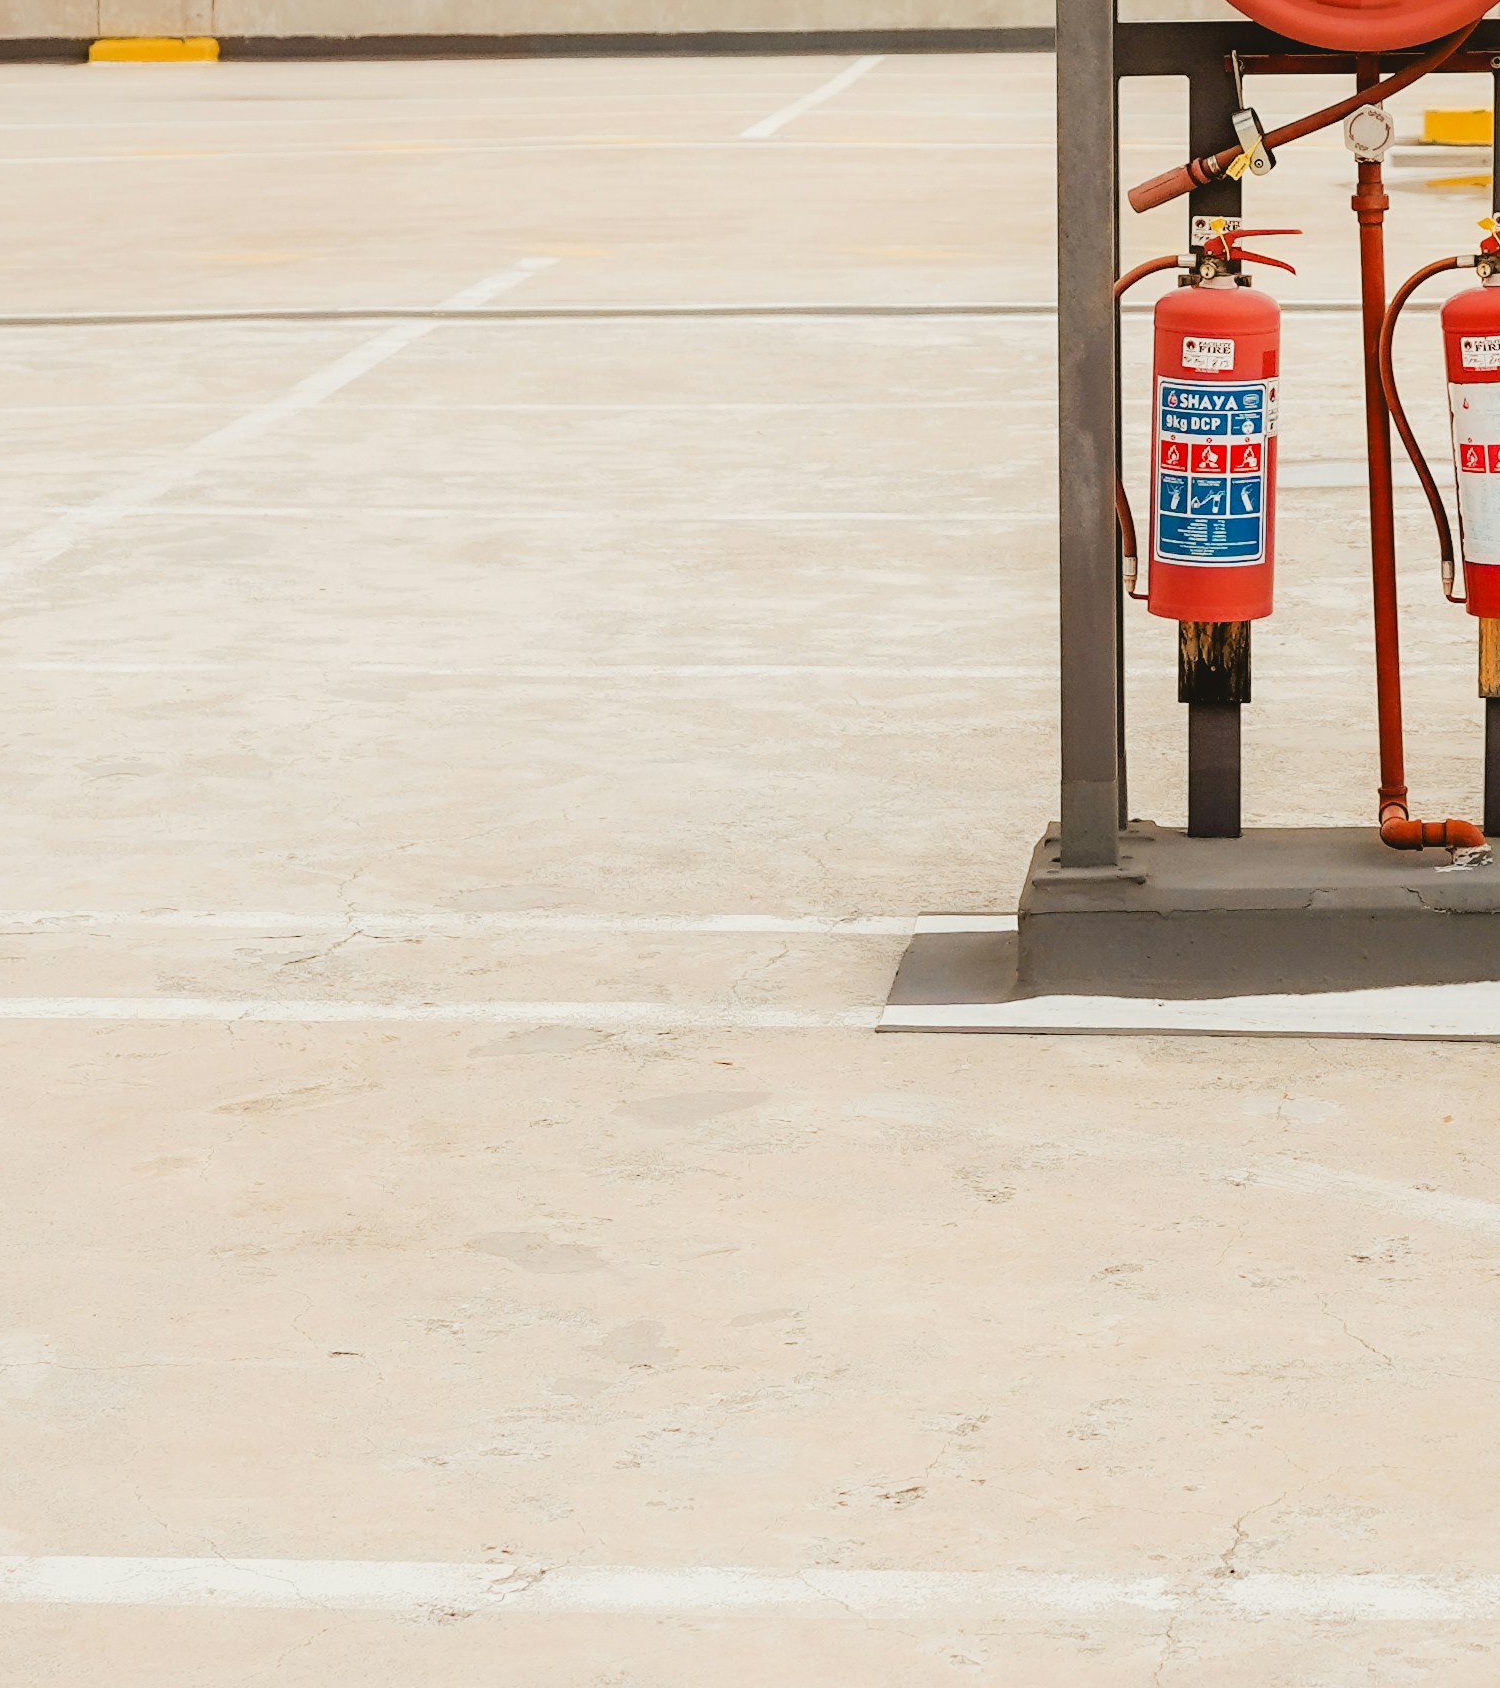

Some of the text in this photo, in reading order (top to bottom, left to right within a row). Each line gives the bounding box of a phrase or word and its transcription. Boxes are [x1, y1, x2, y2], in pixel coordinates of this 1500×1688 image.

[1198, 346, 1231, 354] FIRE
[1180, 393, 1239, 410] SHAYA
[1166, 414, 1188, 432] 9kg
[1191, 417, 1221, 431] DCP
